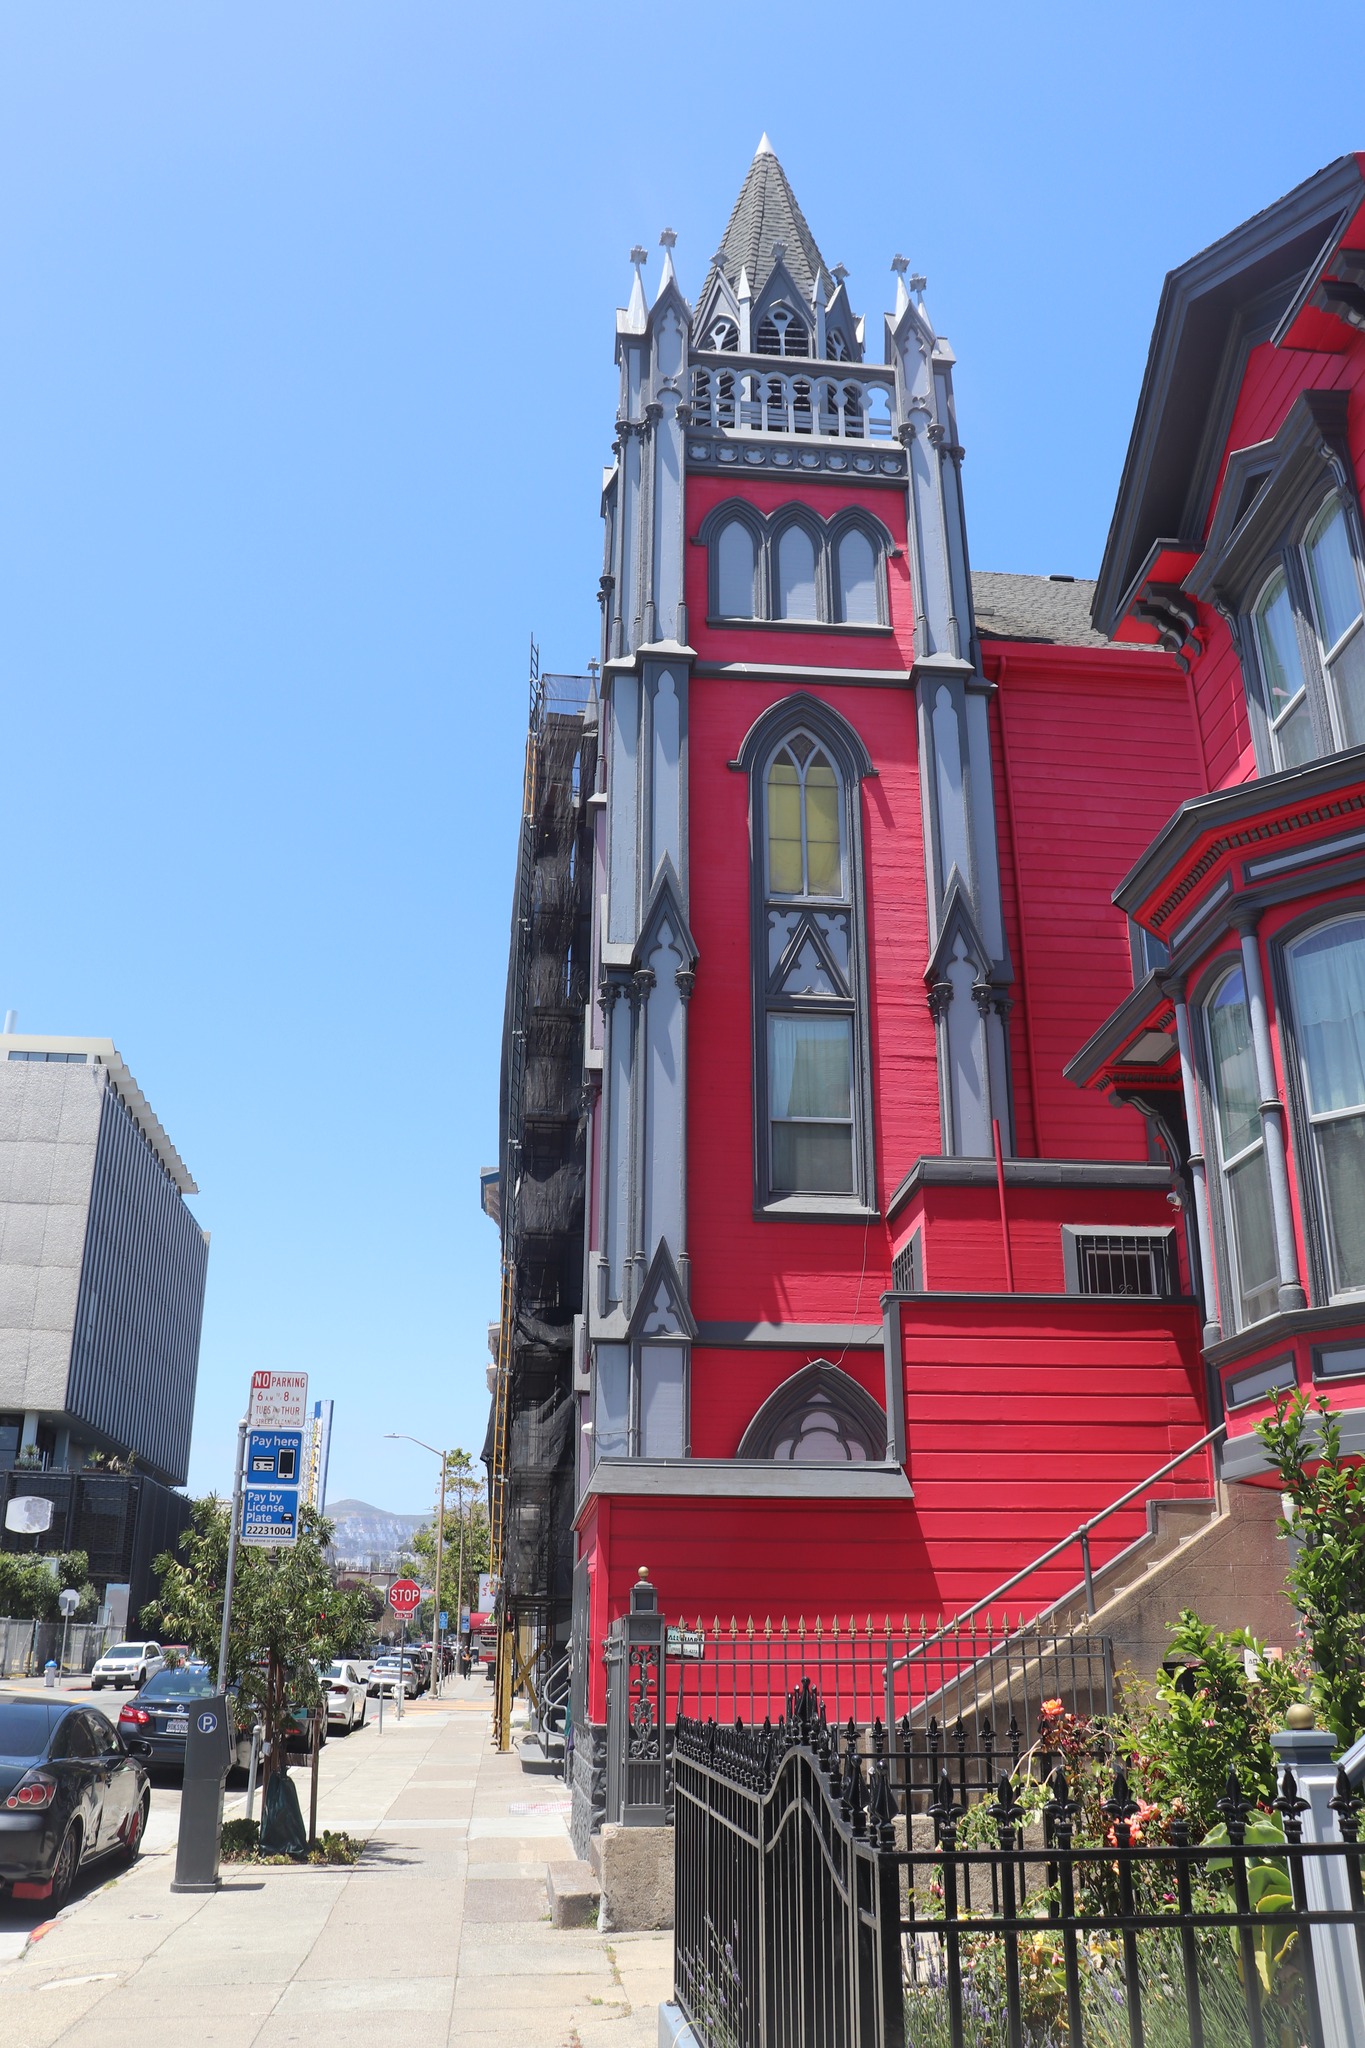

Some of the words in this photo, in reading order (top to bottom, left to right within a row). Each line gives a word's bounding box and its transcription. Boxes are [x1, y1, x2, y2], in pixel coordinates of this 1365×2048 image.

[254, 1373, 270, 1387] NO
[271, 1377, 305, 1388] PARKING
[257, 1391, 263, 1401] 6
[283, 1391, 289, 1401] 8
[256, 1405, 271, 1415] TUES
[281, 1406, 300, 1416] THUR
[252, 1435, 272, 1448] Pay
[273, 1435, 299, 1447] here
[247, 1491, 266, 1504] Pay
[269, 1492, 282, 1504] by
[247, 1502, 284, 1512] License
[246, 1512, 272, 1523] Plate
[246, 1526, 291, 1535] 22231004
[391, 1589, 419, 1602] STOP
